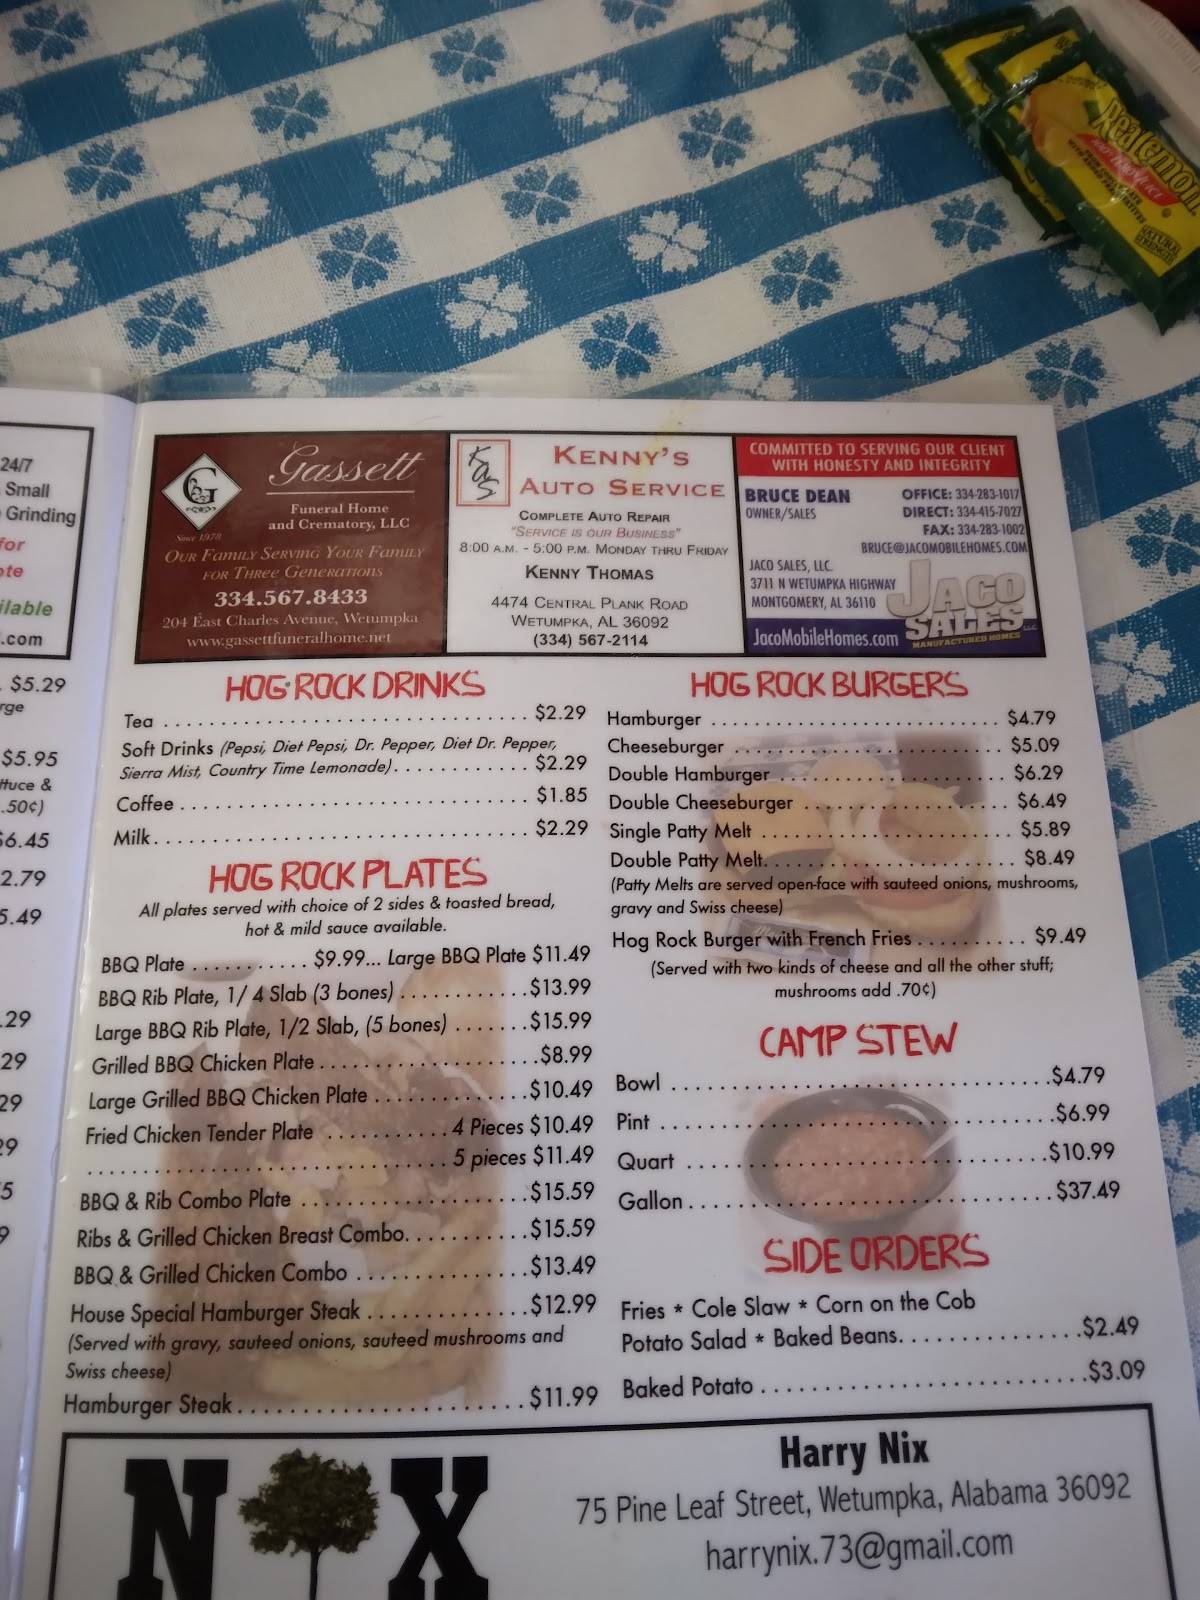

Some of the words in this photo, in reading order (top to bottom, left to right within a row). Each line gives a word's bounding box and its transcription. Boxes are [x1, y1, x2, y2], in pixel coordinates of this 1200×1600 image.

[554, 446, 690, 466] KENNY'S
[750, 442, 832, 456] COMMITTED
[837, 443, 856, 456] TO
[861, 443, 922, 456] SERVING
[927, 443, 954, 456] OUR
[960, 444, 1005, 456] CLIENT
[1, 457, 33, 472] 24/7
[268, 444, 425, 486] Gassett
[772, 459, 808, 472] WITH
[814, 459, 878, 472] HONESTY
[884, 459, 914, 472] AND
[919, 459, 991, 472] INTEGRITY
[5, 482, 50, 498] Small
[520, 478, 594, 496] AUTO
[609, 479, 725, 497] SERVICE
[745, 488, 799, 503] BRUCE
[806, 489, 850, 503] DEAN
[902, 488, 952, 500] OFFICE:
[956, 488, 1019, 500] 334-283-1017
[6, 506, 76, 527] Grinding
[290, 503, 344, 515] Funeral
[348, 503, 389, 514] Home
[519, 510, 583, 521] COMPLETE
[588, 511, 622, 522] AUTO
[627, 511, 670, 522] REPAIR
[745, 508, 816, 521] OWNER/SALES
[903, 506, 953, 518] DIRECT:
[957, 506, 1021, 517] 334-415-7027
[269, 518, 295, 530] and
[298, 517, 375, 532] Crematory,
[380, 518, 410, 529] LLC
[923, 524, 954, 535] FAX:
[957, 524, 1025, 535] 334-283-1002
[459, 542, 489, 553] 8:00
[494, 544, 517, 553] A.M.
[533, 544, 562, 554] 5:00
[567, 545, 589, 554] P.M.
[596, 544, 647, 555] MONDAY
[652, 546, 681, 555] THRU
[687, 545, 728, 556] FRIDAY
[861, 542, 1026, 554] BRUCE@JACOMOBILEHOMES.COM
[526, 565, 579, 579] KENNY
[587, 565, 654, 580] THOMAS
[749, 560, 774, 572] JACO
[778, 559, 810, 573] SALES,
[814, 560, 833, 571] LLC.
[750, 578, 773, 589] 3711
[779, 578, 785, 589] N
[789, 578, 845, 590] WETUMPKA
[850, 579, 896, 590] HIGHWAY
[886, 559, 1025, 617] JACO
[215, 589, 367, 606] 334.567.8433
[491, 597, 528, 608] 4474
[534, 597, 595, 609] CENTRAL
[601, 598, 644, 609] PLANK
[650, 599, 688, 610] ROAD
[751, 596, 826, 609] MONTGOMERY,
[830, 597, 843, 608] AL
[845, 597, 875, 608] 36110
[162, 616, 189, 628] 204
[194, 614, 220, 627] East
[226, 613, 278, 626] Charles
[284, 613, 338, 627] Avenue,
[344, 612, 419, 627] Wetumpka
[511, 615, 592, 629] WETUMPKA,
[598, 616, 618, 628] AL
[623, 616, 668, 629] 36092
[906, 604, 1024, 640] SALES
[186, 631, 391, 648] www.gassettfuneralhome.net
[533, 633, 572, 648] (334)
[579, 634, 648, 646] 567-2114
[753, 628, 898, 647] JacoMobileHomes.com
[10, 675, 66, 693] $5.29
[225, 675, 287, 702] HOG
[295, 672, 366, 700] ROCK
[373, 670, 485, 698] DRINKS
[691, 671, 749, 698] HOG
[757, 671, 825, 697] ROCK
[832, 671, 968, 697] BURGERS
[124, 714, 153, 730] Tea
[535, 705, 586, 722] $2.29
[607, 710, 702, 732] Hamburger
[1007, 709, 1055, 727] $4.79
[607, 738, 724, 758] Cheeseburger
[1011, 736, 1059, 754] $5.09
[2, 749, 58, 767] $5.95
[117, 797, 174, 813] Coffee
[537, 787, 587, 804] $1.85
[114, 829, 150, 846] Milk
[535, 819, 588, 837] $2.29
[610, 823, 662, 843] Single
[667, 823, 707, 843] Patty
[714, 823, 751, 839] Melt
[1021, 820, 1070, 838] $5.89
[209, 863, 273, 893] HOG
[281, 861, 355, 891] ROCK
[362, 856, 487, 889] PLATES
[245, 921, 271, 938] hot
[275, 920, 286, 936] &
[290, 919, 322, 936] mild
[326, 922, 369, 935] sauce
[374, 918, 447, 935] available.
[759, 1023, 846, 1058] CAMP
[857, 1022, 958, 1057] STEW
[92, 1055, 149, 1076] Grilled
[155, 1055, 194, 1075] BBQ
[200, 1052, 267, 1073] Chicken
[274, 1052, 314, 1072] Plate
[540, 1045, 592, 1066] $8.99
[616, 1073, 660, 1093] Bowl
[1051, 1065, 1104, 1086] $4.79
[617, 1112, 650, 1131] Pint
[1055, 1103, 1109, 1124] $6.99
[618, 1152, 674, 1174] Quart
[1049, 1142, 1115, 1163] $10.99
[618, 1191, 683, 1211] Gallon
[1056, 1180, 1120, 1202] $37.49
[763, 1237, 841, 1274] SIDE
[849, 1234, 990, 1272] ORDERS
[621, 1301, 665, 1321] Fries
[691, 1298, 738, 1318] Cole
[745, 1296, 791, 1317] Slaw
[816, 1295, 863, 1314] Corn
[870, 1296, 894, 1312] on
[901, 1293, 929, 1312] the
[936, 1290, 975, 1311] Cob
[623, 1378, 683, 1400] Baked
[691, 1376, 753, 1398] Potato
[1088, 1360, 1145, 1383] $3.09
[64, 1393, 172, 1418] Hamburger
[178, 1394, 232, 1415] Steak
[530, 1385, 598, 1410] $11.99
[780, 1436, 867, 1475] Harry
[880, 1431, 929, 1464] Nix
[576, 1497, 607, 1525] 75
[616, 1497, 667, 1523] Pine
[676, 1491, 725, 1520] Leaf
[736, 1487, 812, 1519] Street,
[818, 1483, 943, 1517] Wetumpka,
[951, 1479, 1049, 1508] Alabama
[1057, 1472, 1131, 1502] 36092
[706, 1529, 1013, 1576] harrynix.73@gmail.com
